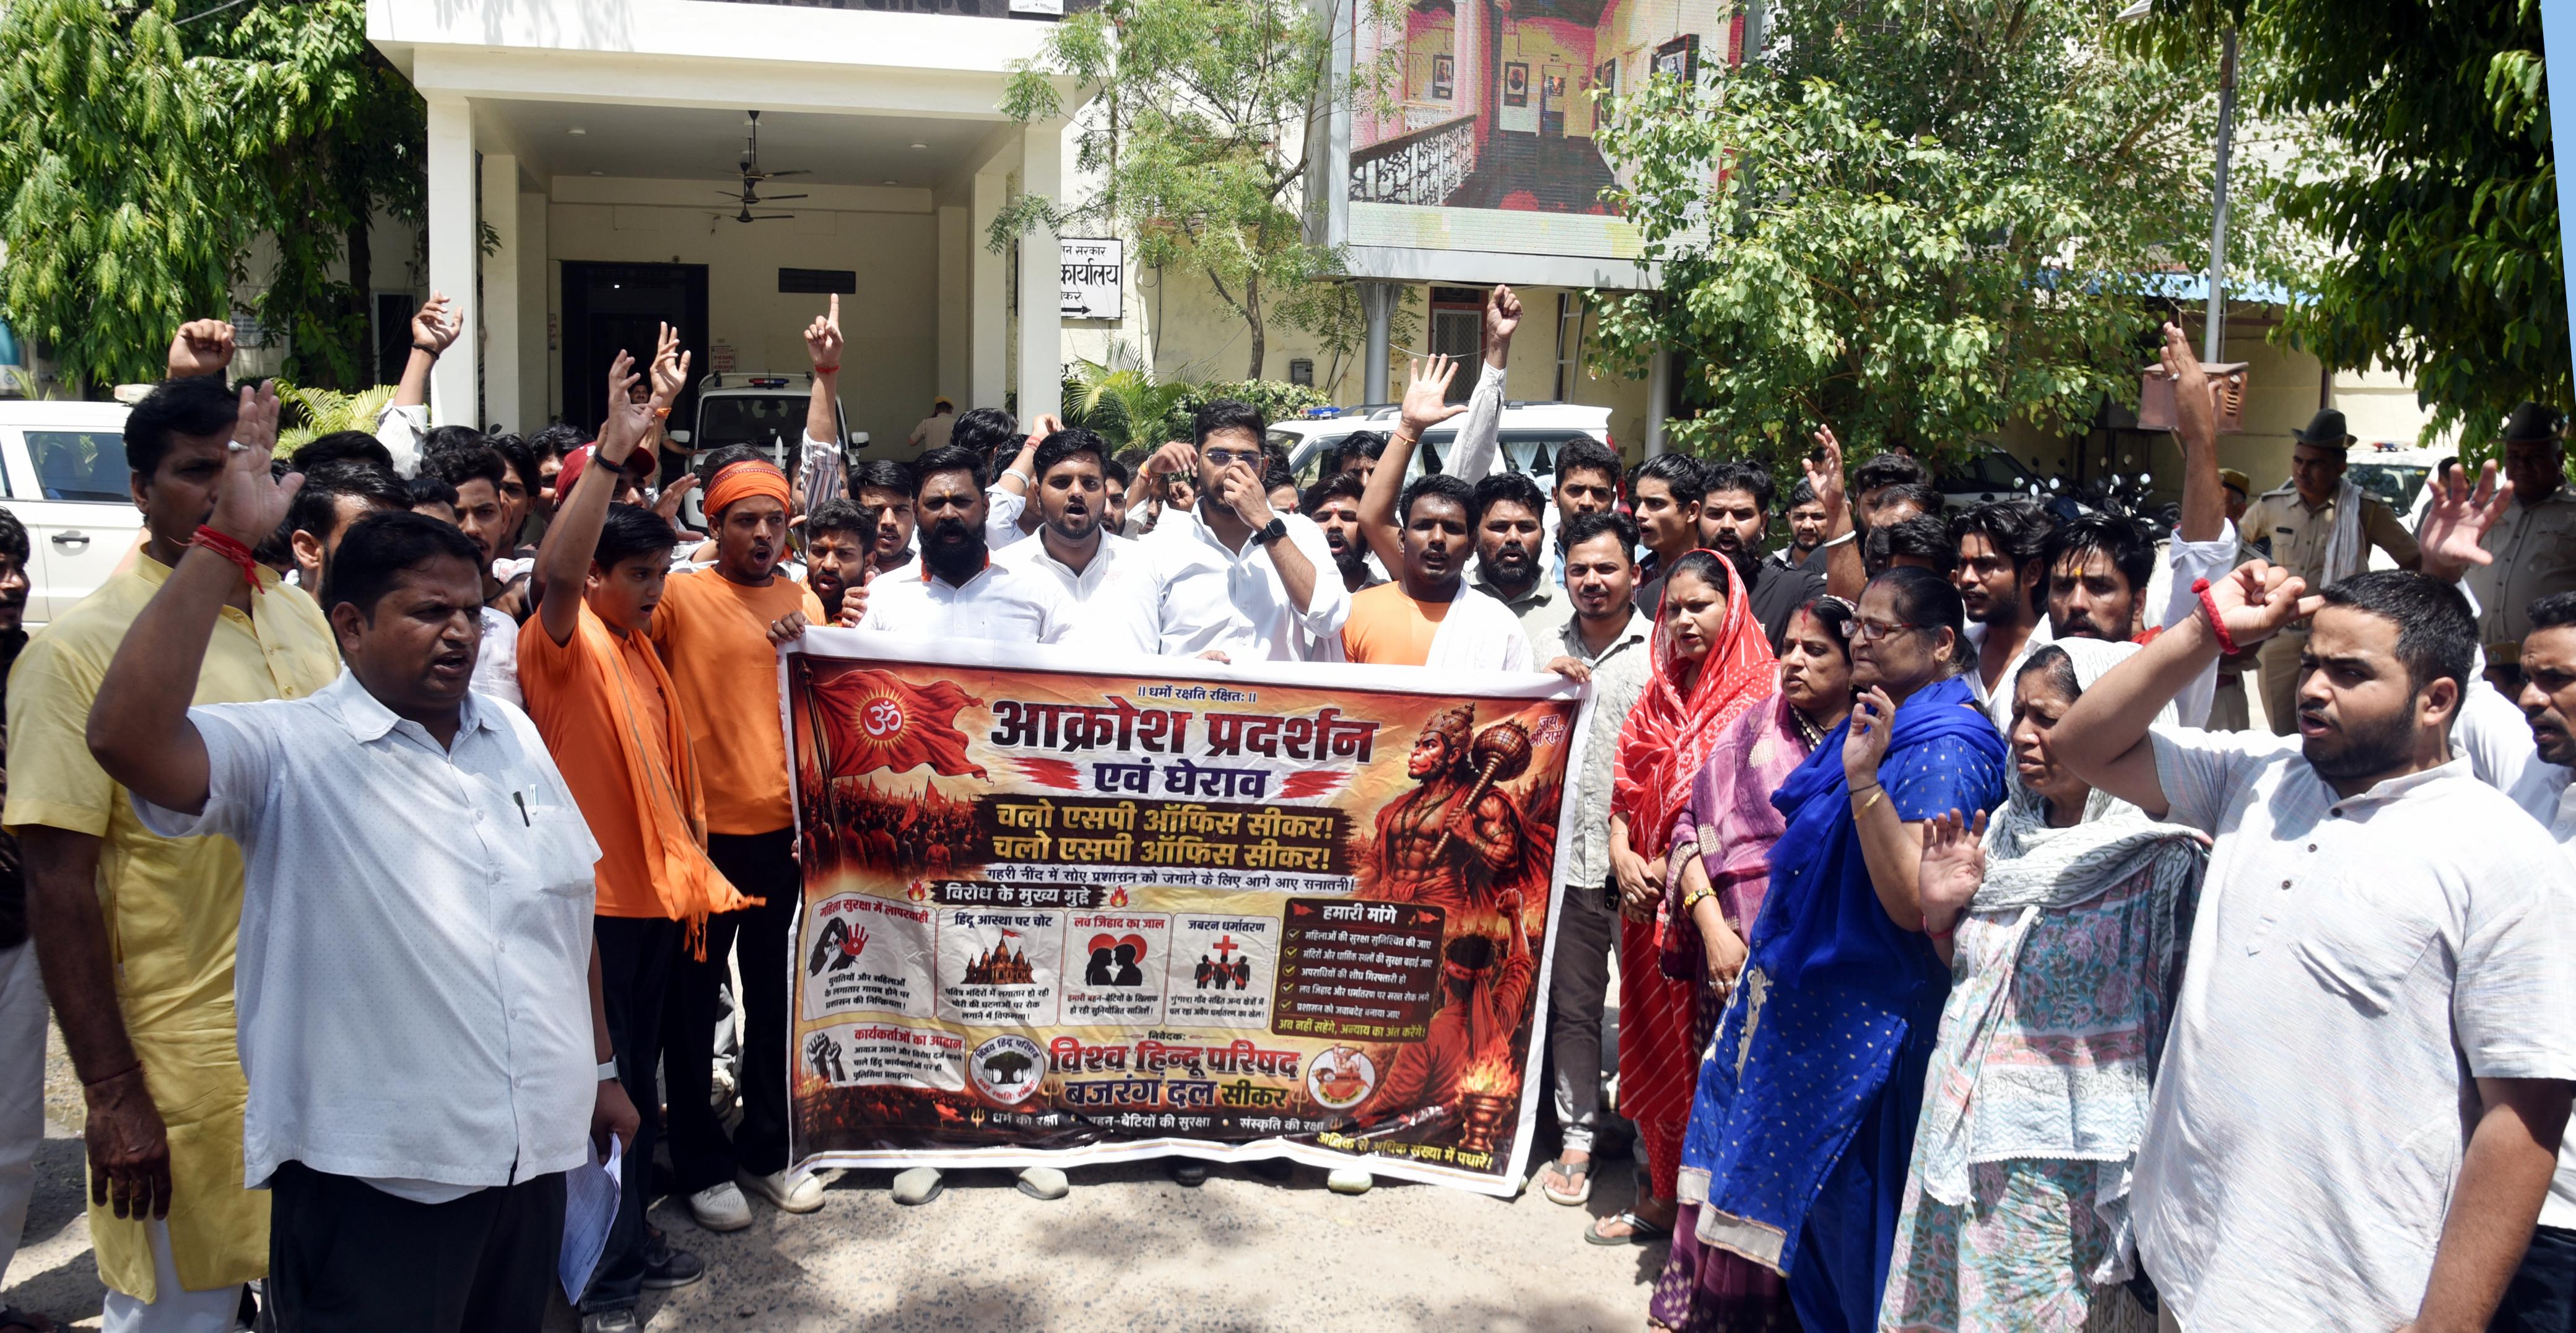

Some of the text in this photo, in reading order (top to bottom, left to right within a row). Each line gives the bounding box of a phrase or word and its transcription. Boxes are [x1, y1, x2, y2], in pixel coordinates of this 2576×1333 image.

[1075, 246, 1107, 257] सरकार
[1149, 685, 1206, 701] धर्मो रक्षति
[991, 696, 1382, 764] आक्रोश प्रदर्शन
[1539, 714, 1560, 729] जय
[1530, 727, 1544, 746] श्री
[1093, 758, 1270, 798] एवं घेराव
[997, 799, 1333, 839] चलो एसपी ऑफिस सीकर!
[993, 830, 1329, 870] चलो एसपी ऑफिस सीकर!
[986, 865, 1355, 891] गहरी नींद में सोए प्रशासन को जगाने के लिए आगे आए सनातनी!
[945, 883, 1091, 907] विरोध के मुख्य मुद्दे
[820, 899, 928, 924] महिला सुरक्षा में लापरवाही
[955, 912, 1053, 928] हिंदू आस्था पर चोट
[1323, 903, 1398, 924] हमारी मांगे
[1074, 916, 1165, 929] लव जिहाद का जाल
[1188, 920, 1219, 930] जबरन
[1305, 930, 1432, 949] महिलाओं की सुरक्षा की जाए
[1323, 948, 1336, 959] और
[1375, 952, 1385, 964] की
[1385, 955, 1403, 967] सुरक्षा
[1419, 958, 1433, 968] जाए
[857, 972, 871, 981] और
[1338, 968, 1347, 979] की
[1399, 974, 1406, 984] हो
[853, 995, 864, 1004] की
[1027, 989, 1035, 997] हो
[1038, 987, 1050, 997] रही
[1068, 993, 1086, 1002] हमारी
[1126, 993, 1133, 1002] के
[1312, 984, 1332, 995] जिहाद
[1333, 985, 1346, 997] और
[969, 999, 980, 1008] की
[1070, 1005, 1076, 1015] हो
[1078, 1005, 1089, 1014] रही
[1323, 1003, 1334, 1014] को
[1386, 1010, 1400, 1019] जाए
[854, 1025, 927, 1046] कार्यकर्ताओं का
[1278, 1018, 1293, 1030] अब
[1295, 1018, 1313, 1031] नहीं
[1340, 1025, 1370, 1036] अन्याय
[1372, 1025, 1384, 1037] का
[1386, 1025, 1400, 1036] अंत
[899, 1047, 911, 1056] और
[1048, 1036, 1303, 1081] विश्व हिन्दू परिषद
[1065, 1072, 1165, 1106] बजरंग
[1166, 1077, 1219, 1107] दल
[1221, 1078, 1290, 1109] सीकर
[993, 1112, 1325, 1132] धर्म की रक्षा की सुरक्षा संस्कृति की रक्षा
[1410, 1144, 1442, 1161] संख्या
[1443, 1146, 1456, 1163] में
